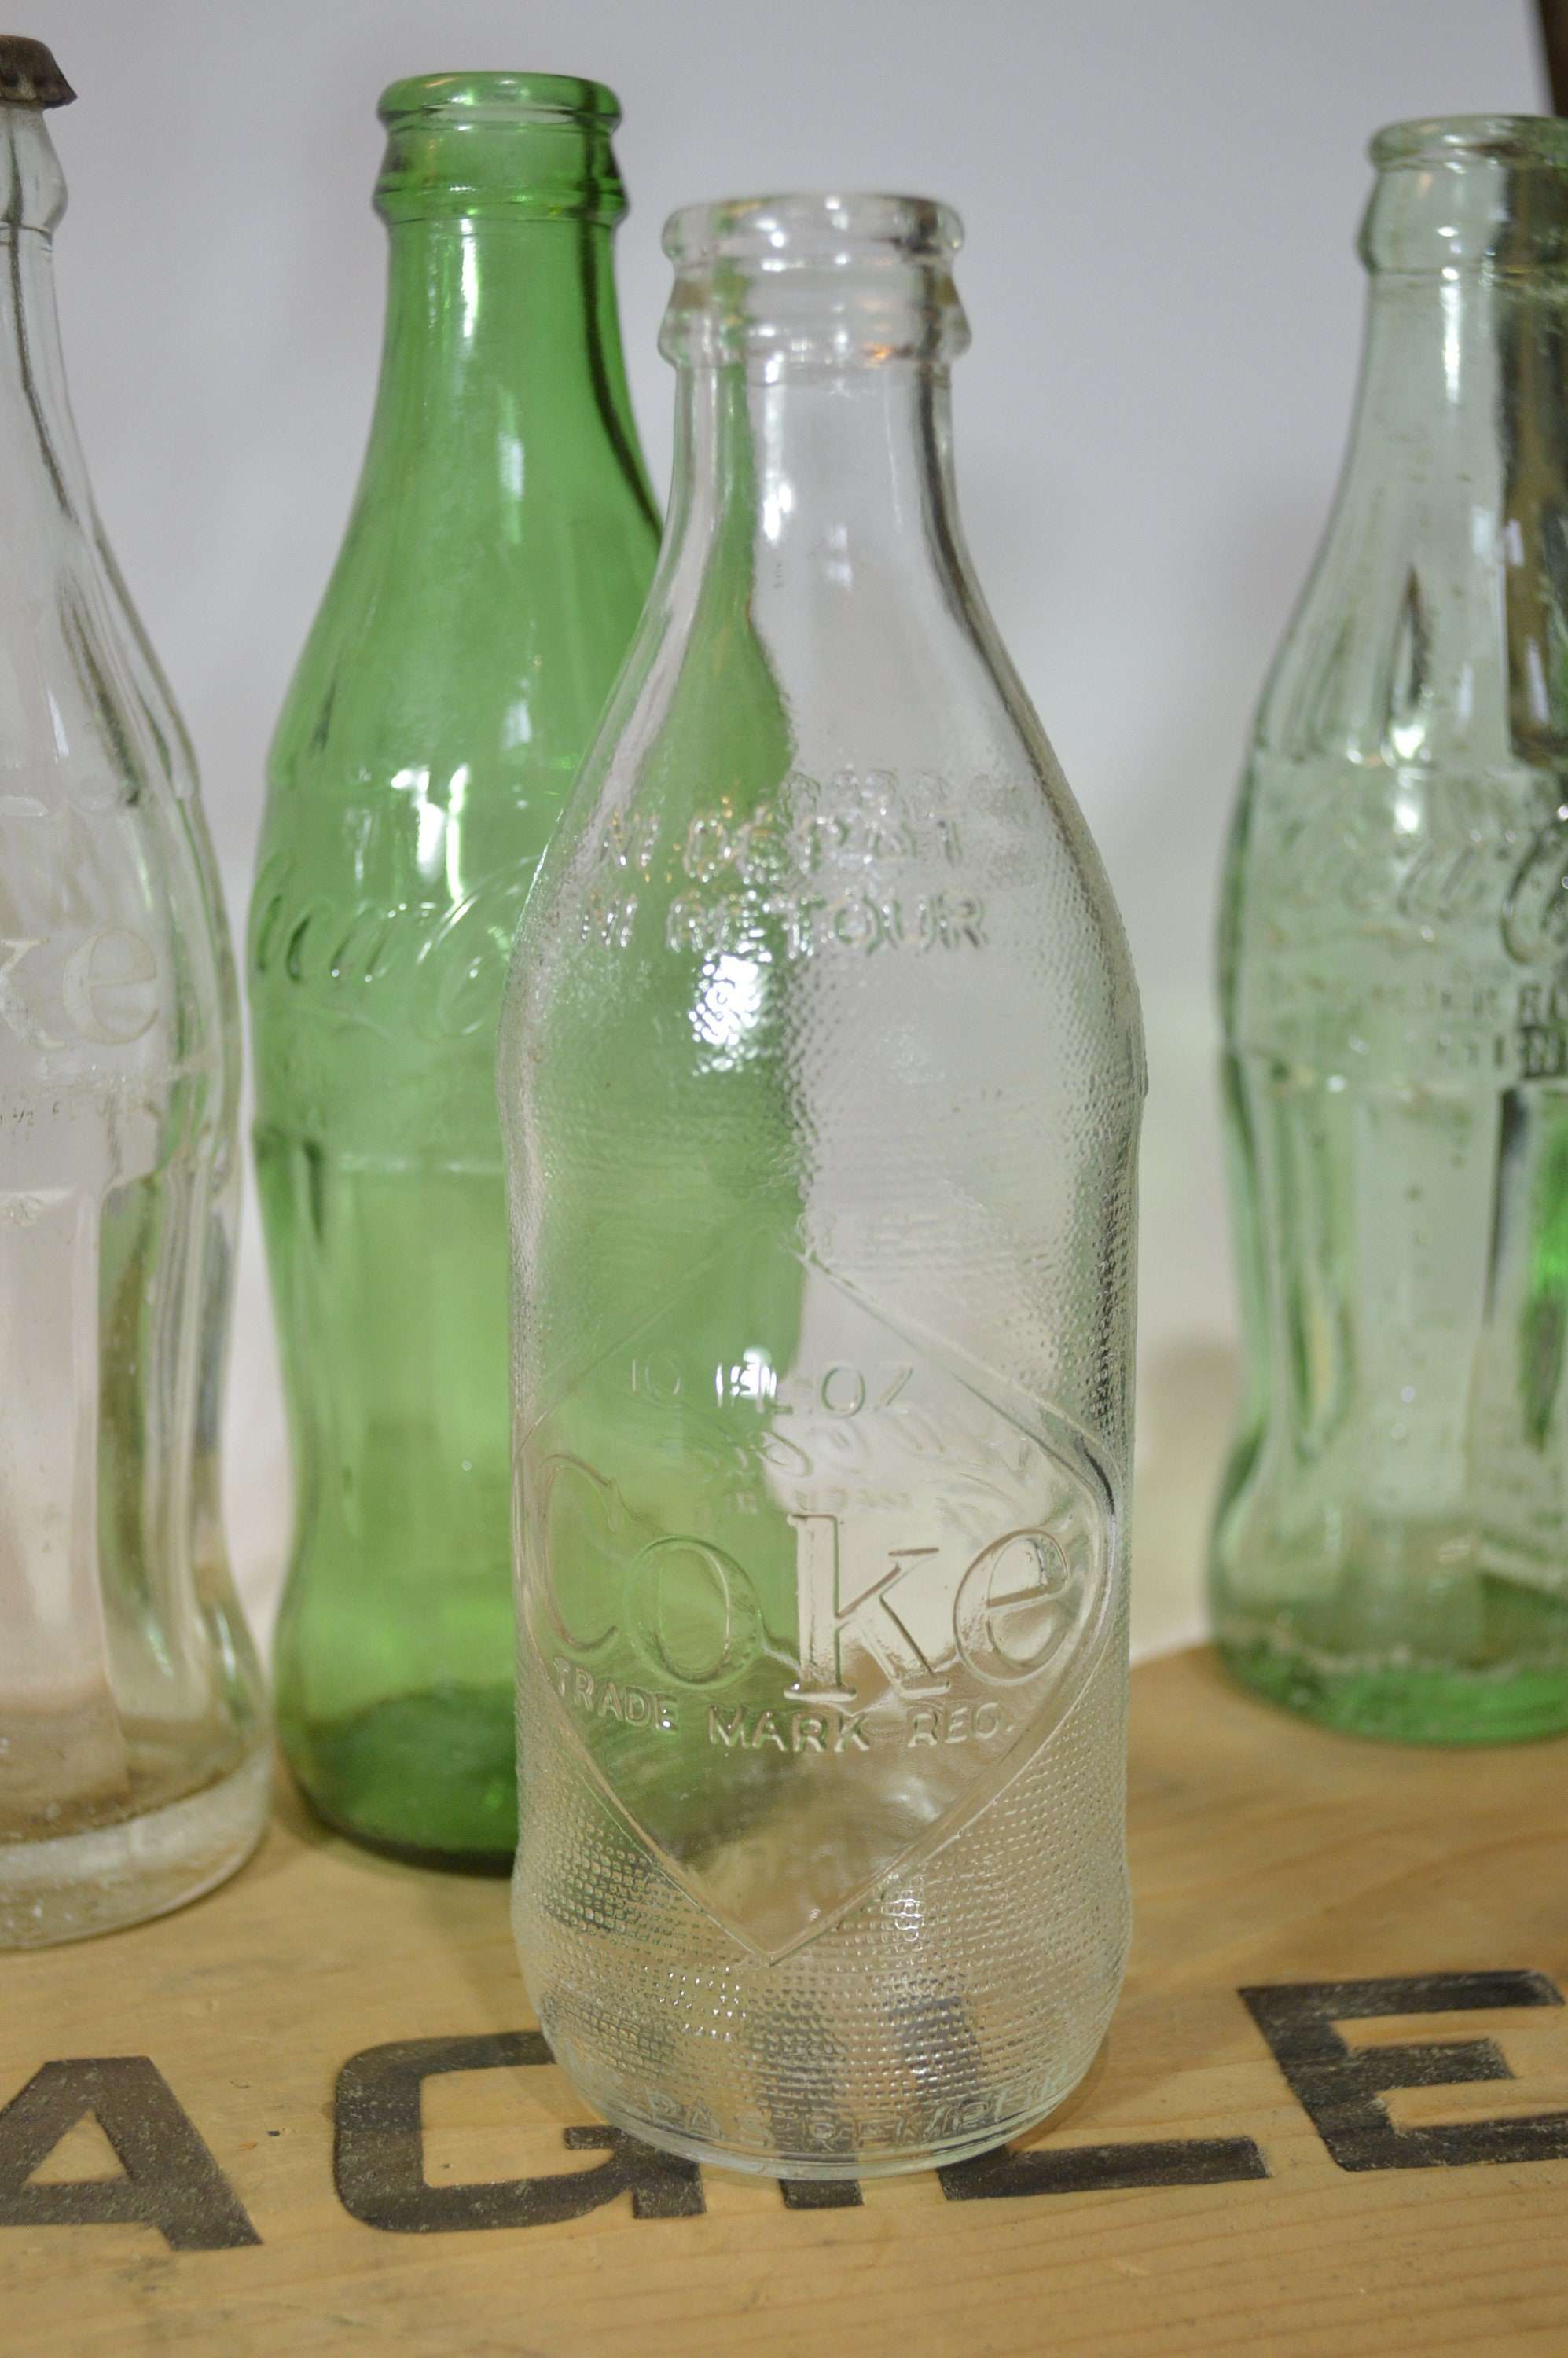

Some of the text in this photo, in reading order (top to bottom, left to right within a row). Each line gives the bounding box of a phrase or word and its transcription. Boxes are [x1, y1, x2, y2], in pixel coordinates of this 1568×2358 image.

[820, 1361, 915, 1417] OZ
[539, 1453, 1069, 1702] Coke
[553, 1655, 679, 1730] TRADE
[709, 1704, 871, 1754] MARK
